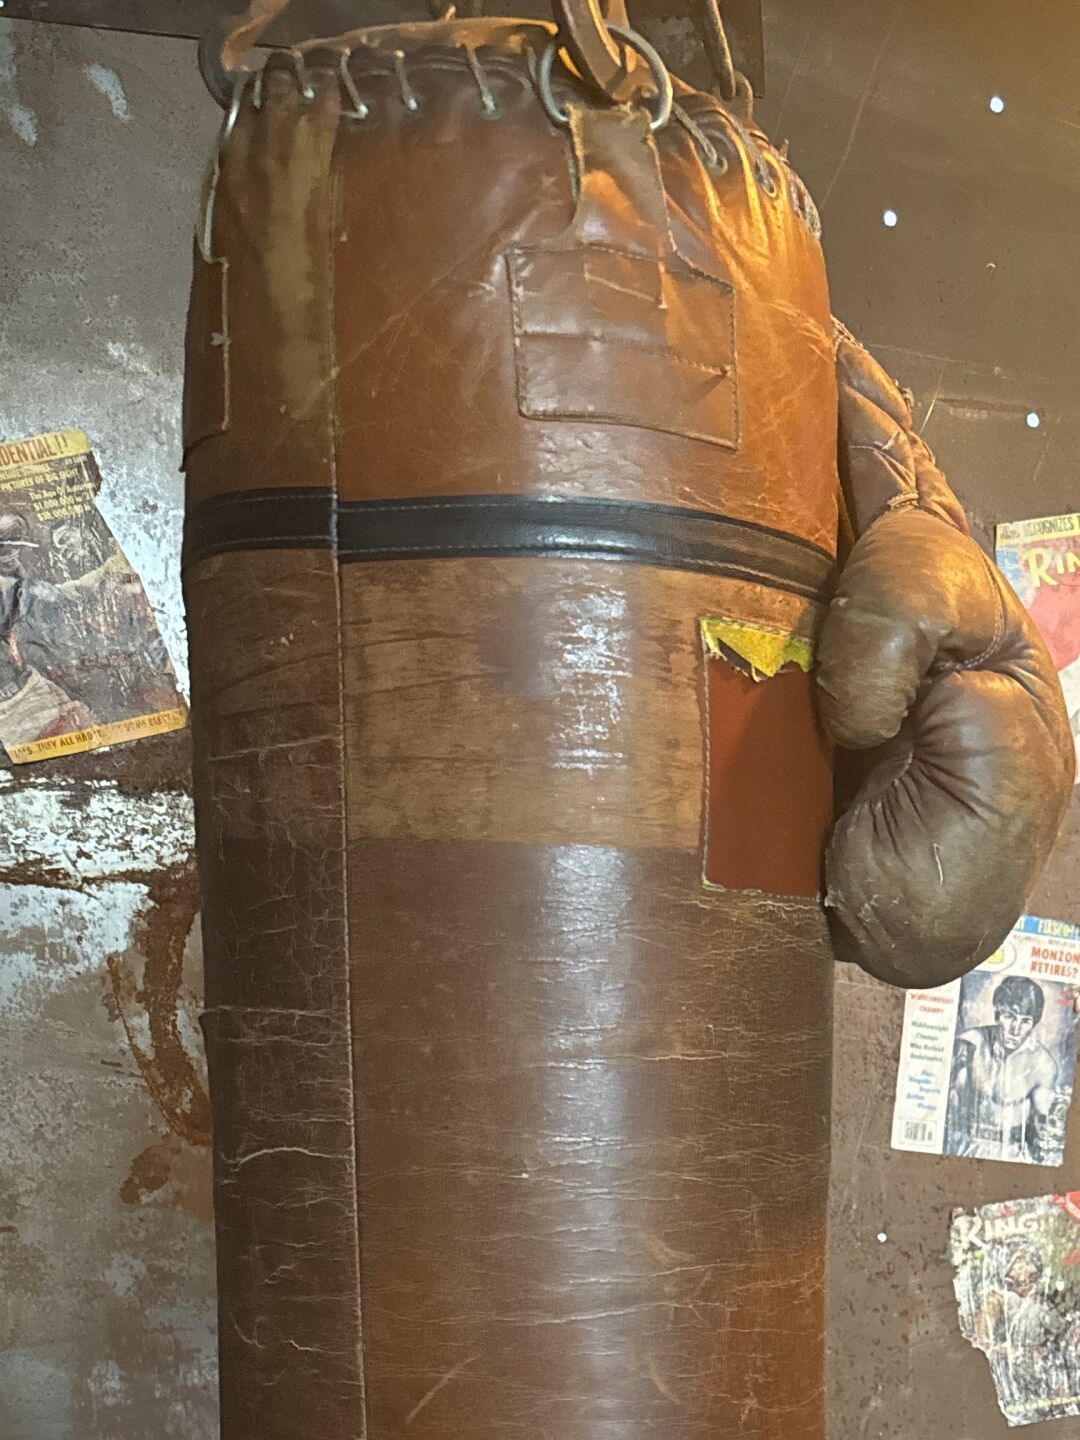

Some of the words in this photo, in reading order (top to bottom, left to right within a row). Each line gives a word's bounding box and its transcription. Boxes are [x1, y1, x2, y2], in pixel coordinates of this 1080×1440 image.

[1023, 517, 1074, 538] ECOGNIZES
[60, 735, 74, 747] ALL
[1031, 946, 1080, 965] MONZON
[1029, 961, 1078, 979] RETIRES?
